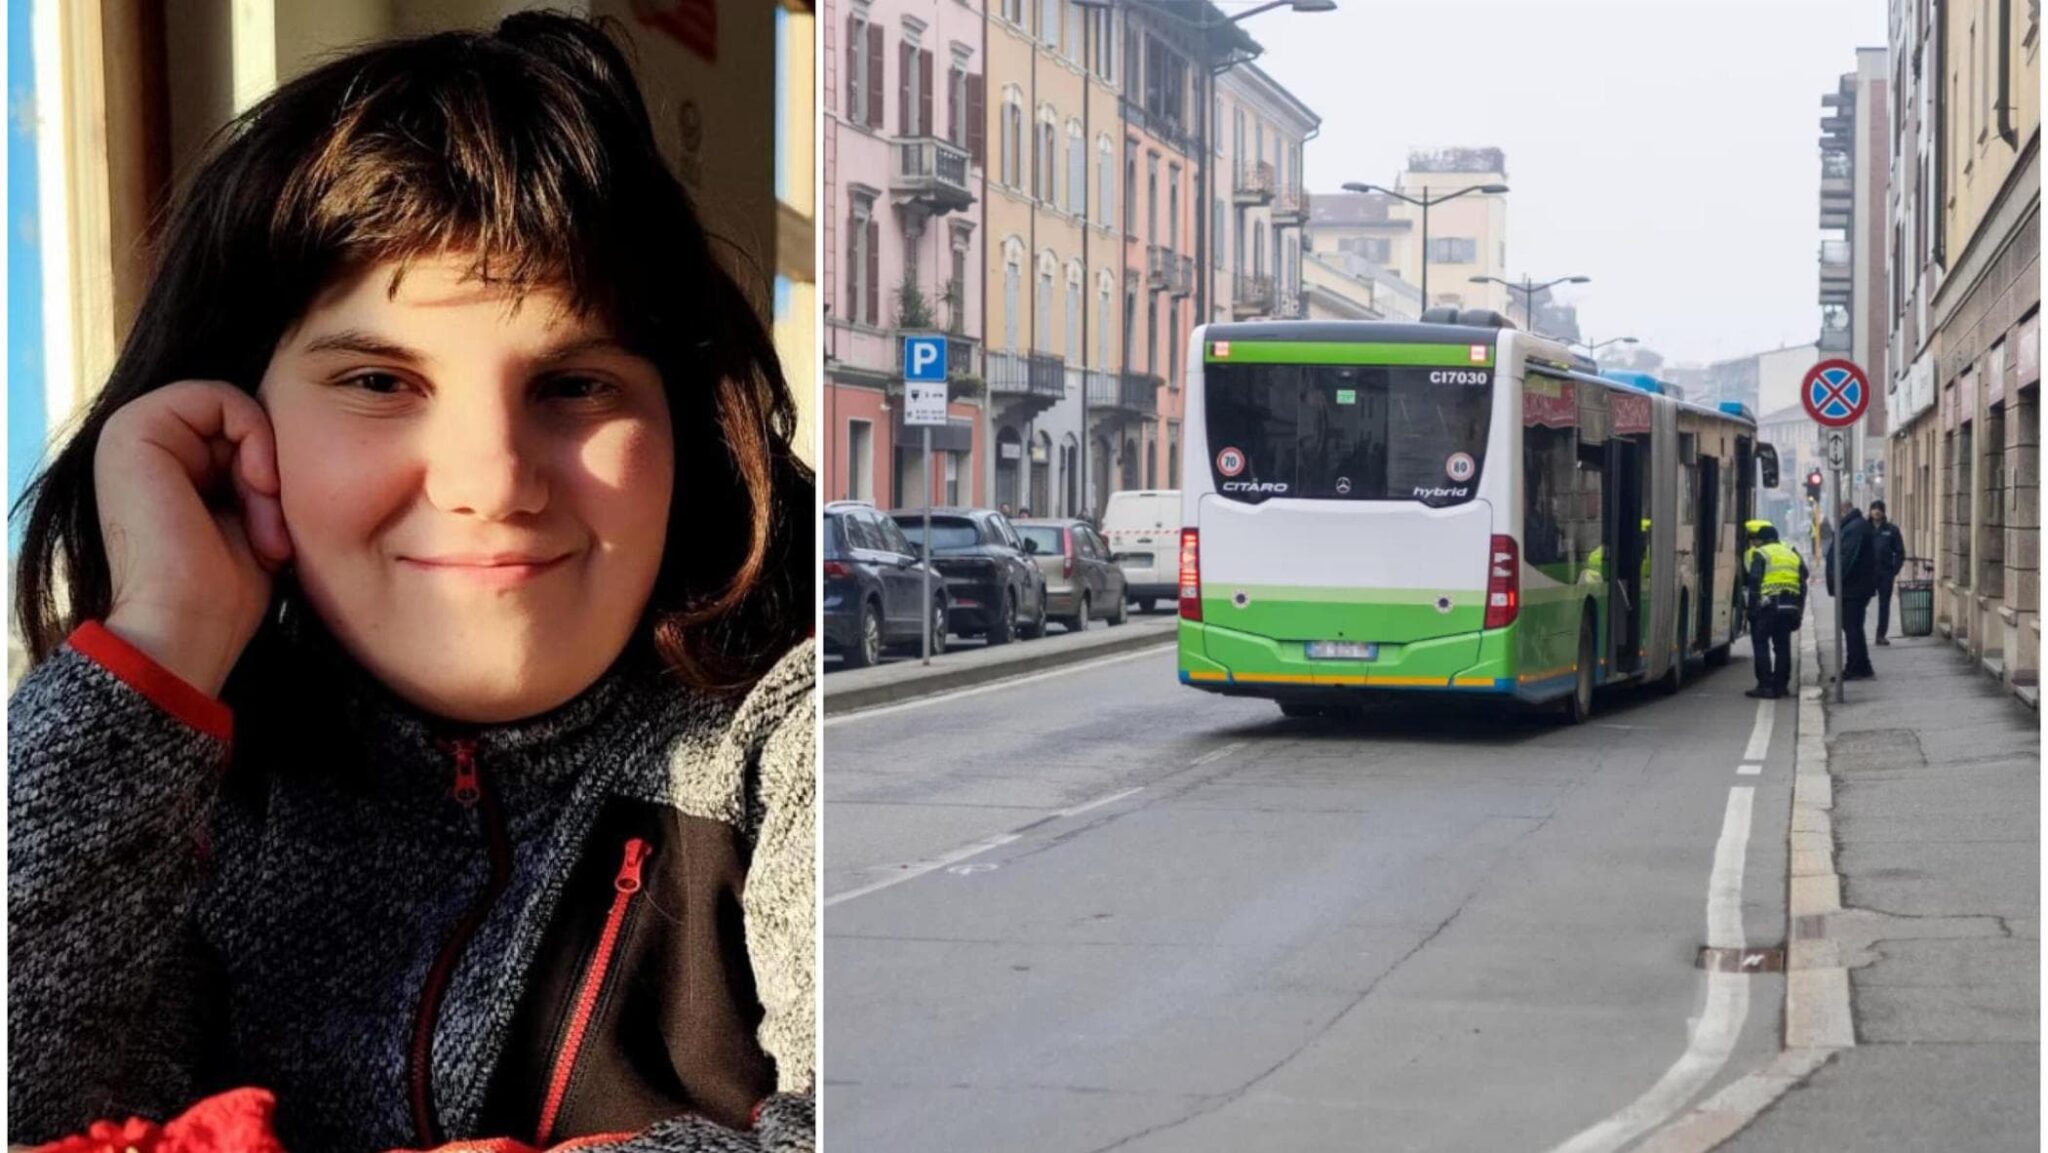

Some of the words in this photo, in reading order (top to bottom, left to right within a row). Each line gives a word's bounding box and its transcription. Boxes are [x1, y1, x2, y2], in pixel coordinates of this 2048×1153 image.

[913, 343, 937, 375] P
[1430, 371, 1487, 384] CI7030
[1225, 456, 1237, 468] 70
[1223, 482, 1288, 492] CITARO
[1413, 487, 1468, 498] hybrid
